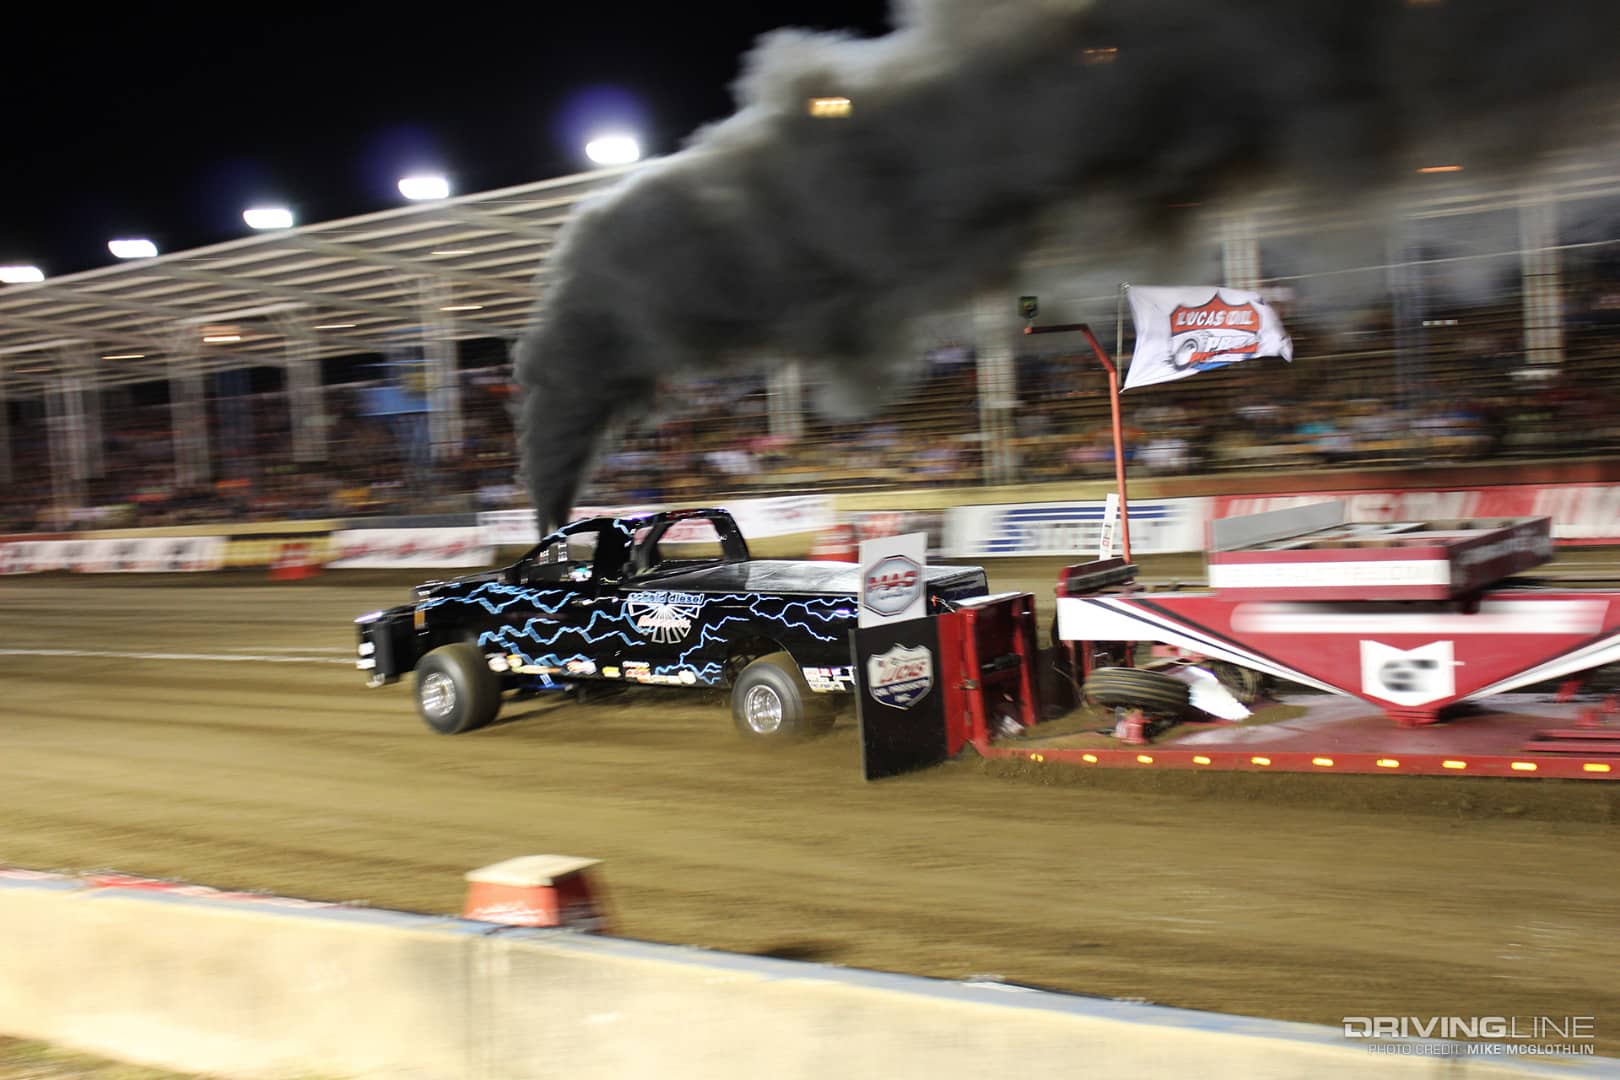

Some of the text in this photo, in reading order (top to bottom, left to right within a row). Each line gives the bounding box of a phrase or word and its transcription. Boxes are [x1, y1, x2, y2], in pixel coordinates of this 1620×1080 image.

[1176, 310, 1256, 326] LUCAS OIL
[668, 592, 704, 604] diesel
